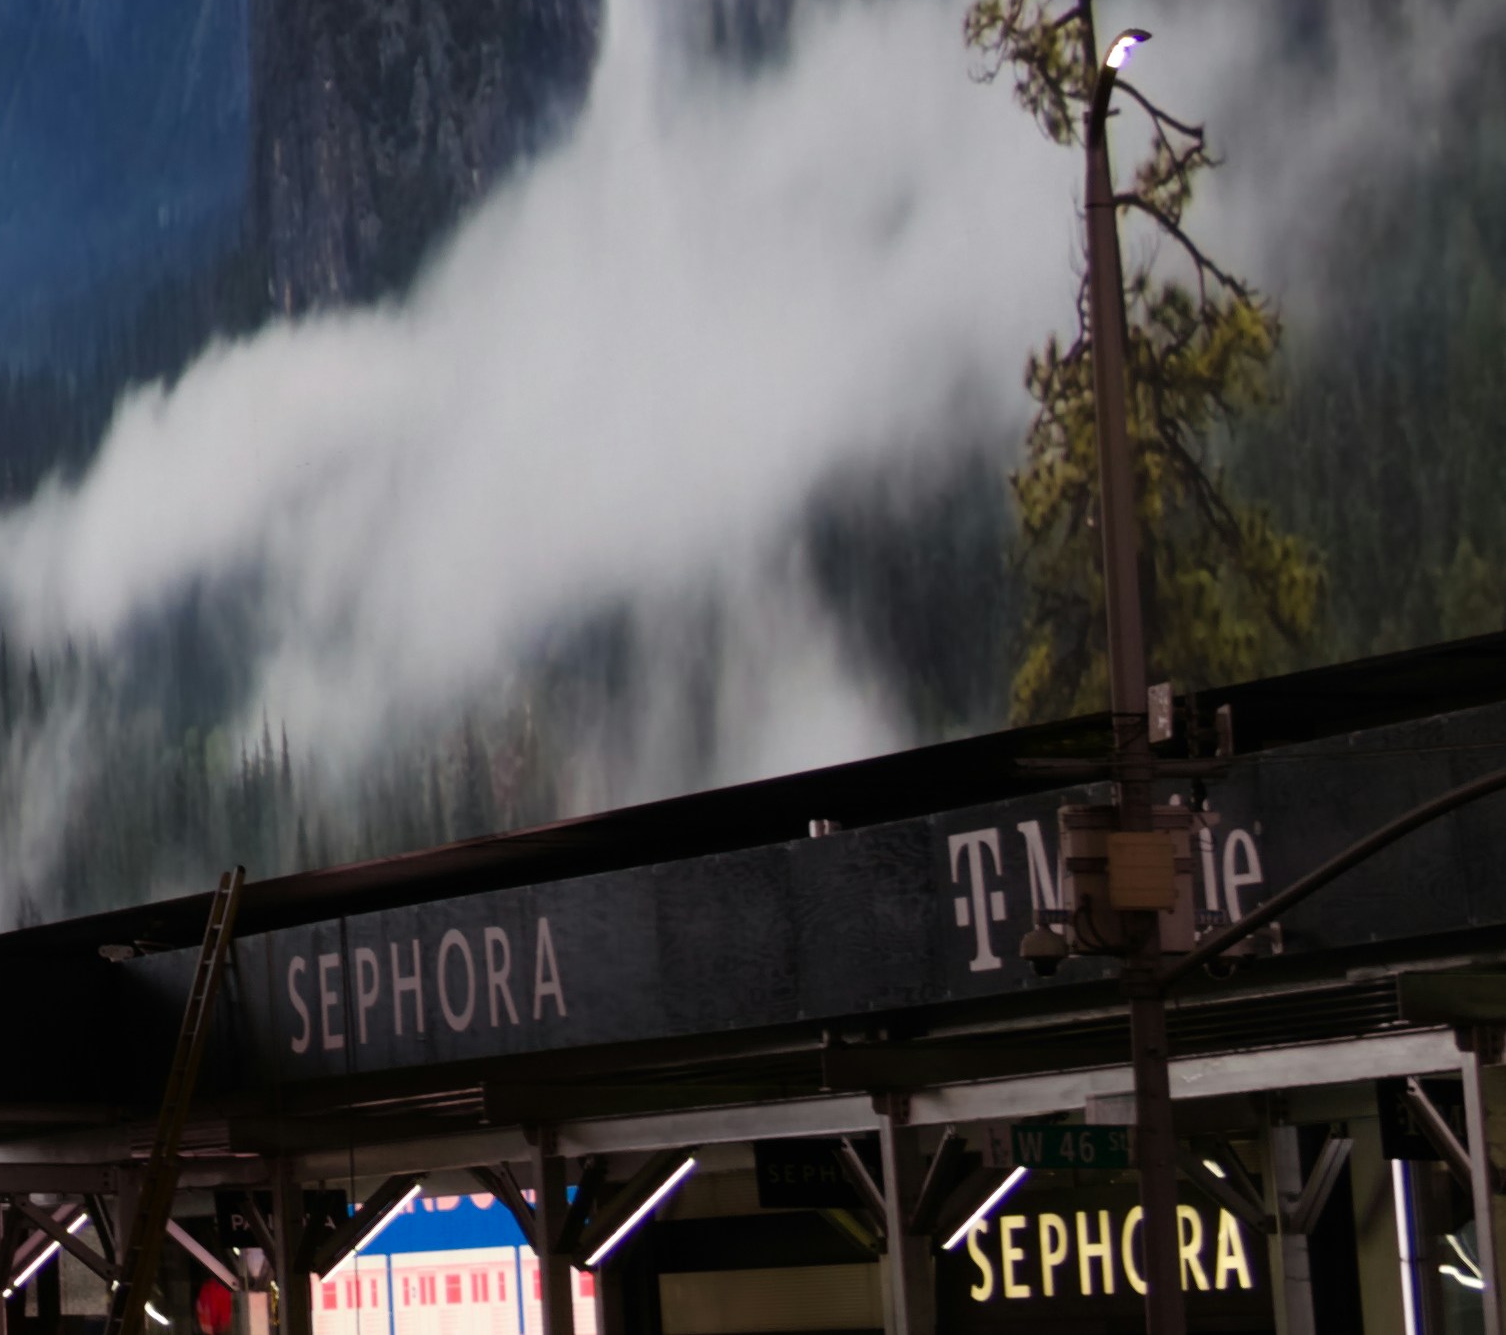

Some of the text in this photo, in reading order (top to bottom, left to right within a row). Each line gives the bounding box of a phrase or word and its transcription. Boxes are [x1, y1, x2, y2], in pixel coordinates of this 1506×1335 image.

[288, 916, 567, 1055] SEPHORA
[1016, 1131, 1045, 1164] W
[1058, 1130, 1096, 1164] 46
[967, 1204, 1253, 1302] SEPHORA
